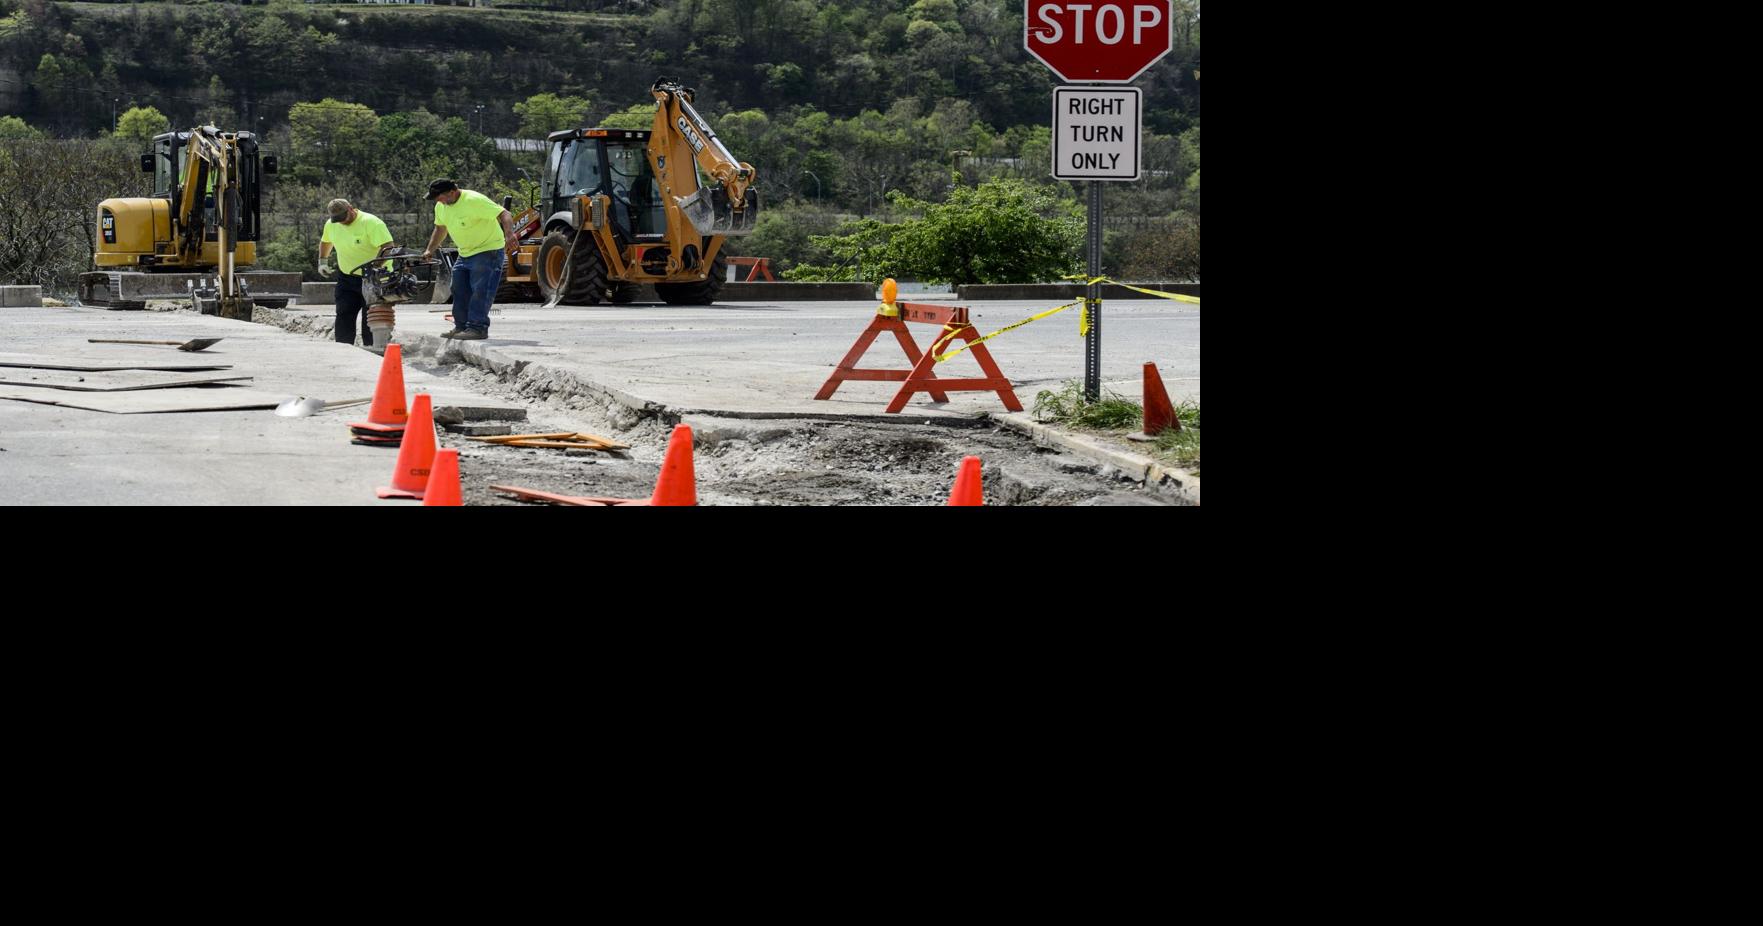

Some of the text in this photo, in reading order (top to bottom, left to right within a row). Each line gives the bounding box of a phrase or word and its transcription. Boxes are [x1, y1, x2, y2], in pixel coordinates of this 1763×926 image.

[1034, 4, 1162, 45] STOP
[1068, 98, 1125, 115] RIGHT
[678, 116, 703, 152] CASE
[1070, 125, 1124, 142] TURN
[1071, 152, 1121, 170] ONLY
[103, 217, 113, 229] CAT
